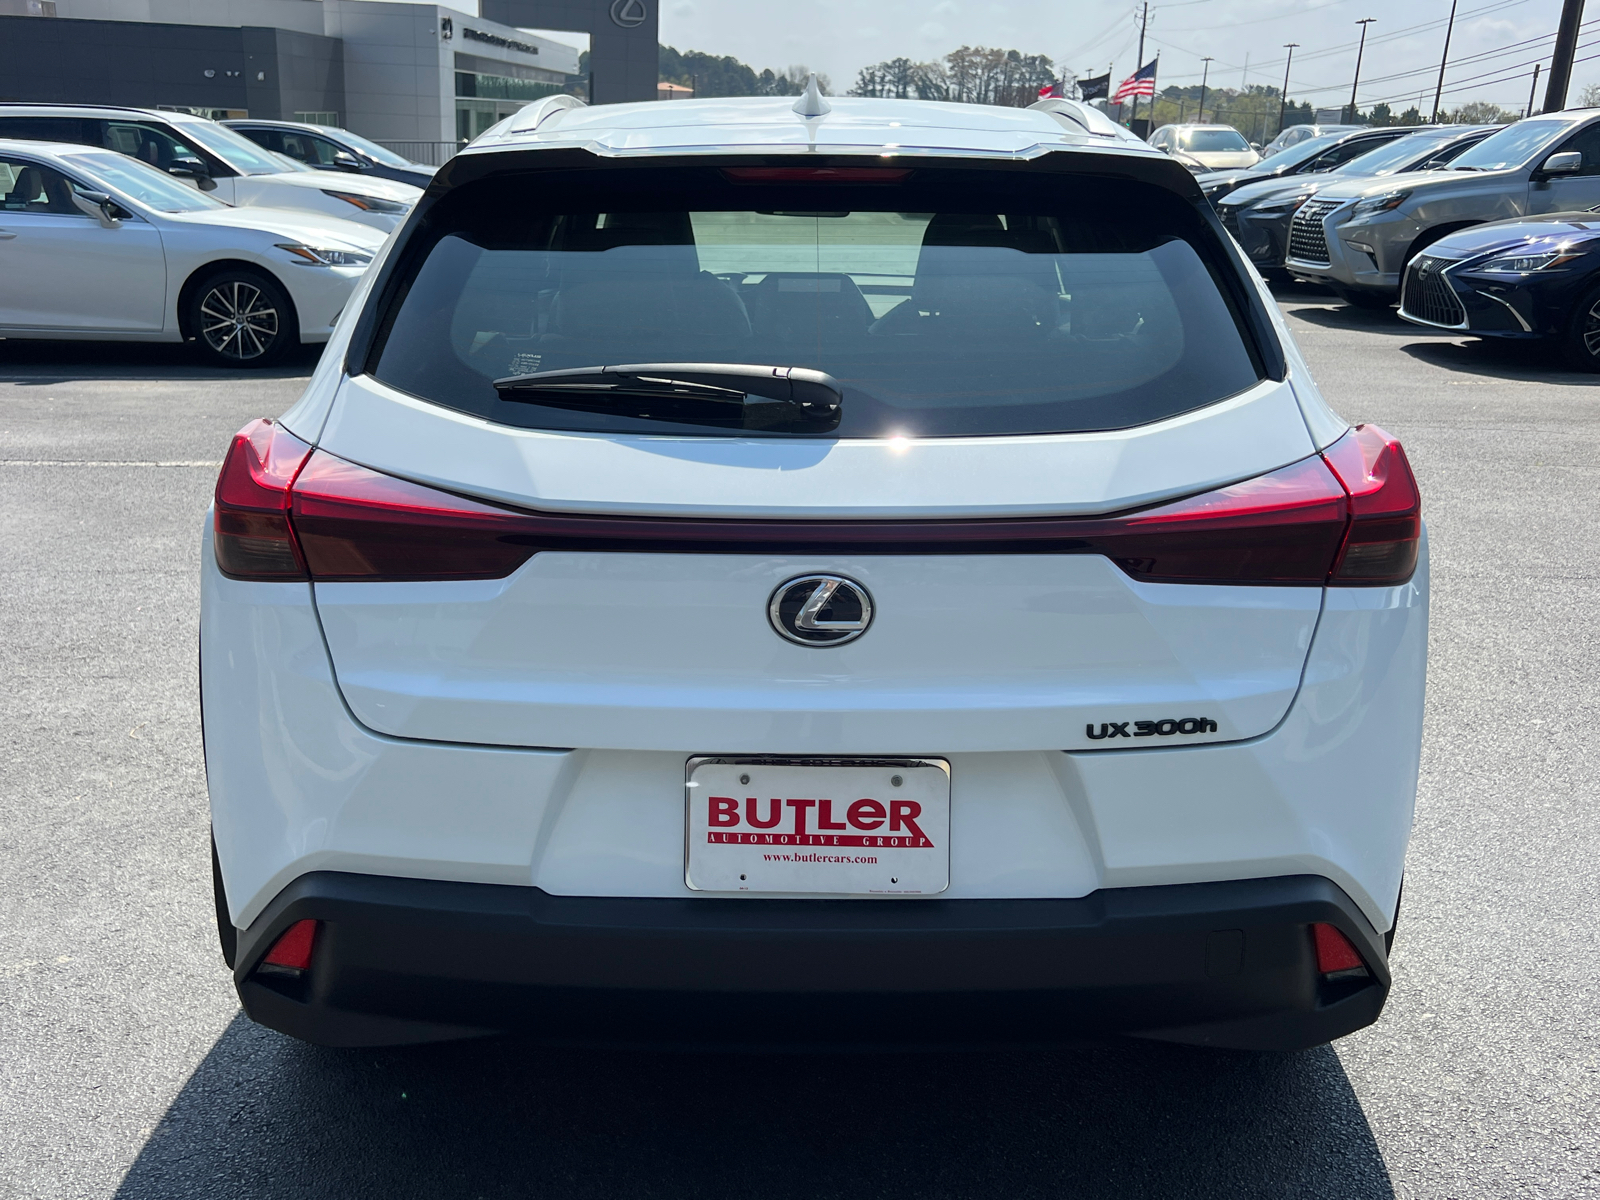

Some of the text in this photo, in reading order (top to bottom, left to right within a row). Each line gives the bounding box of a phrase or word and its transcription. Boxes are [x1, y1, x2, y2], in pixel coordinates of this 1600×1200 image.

[1086, 717, 1217, 739] UX 300h
[709, 833, 926, 847] AUTOMOTIVE GROUP
[763, 853, 878, 864] www.butlercars.com
